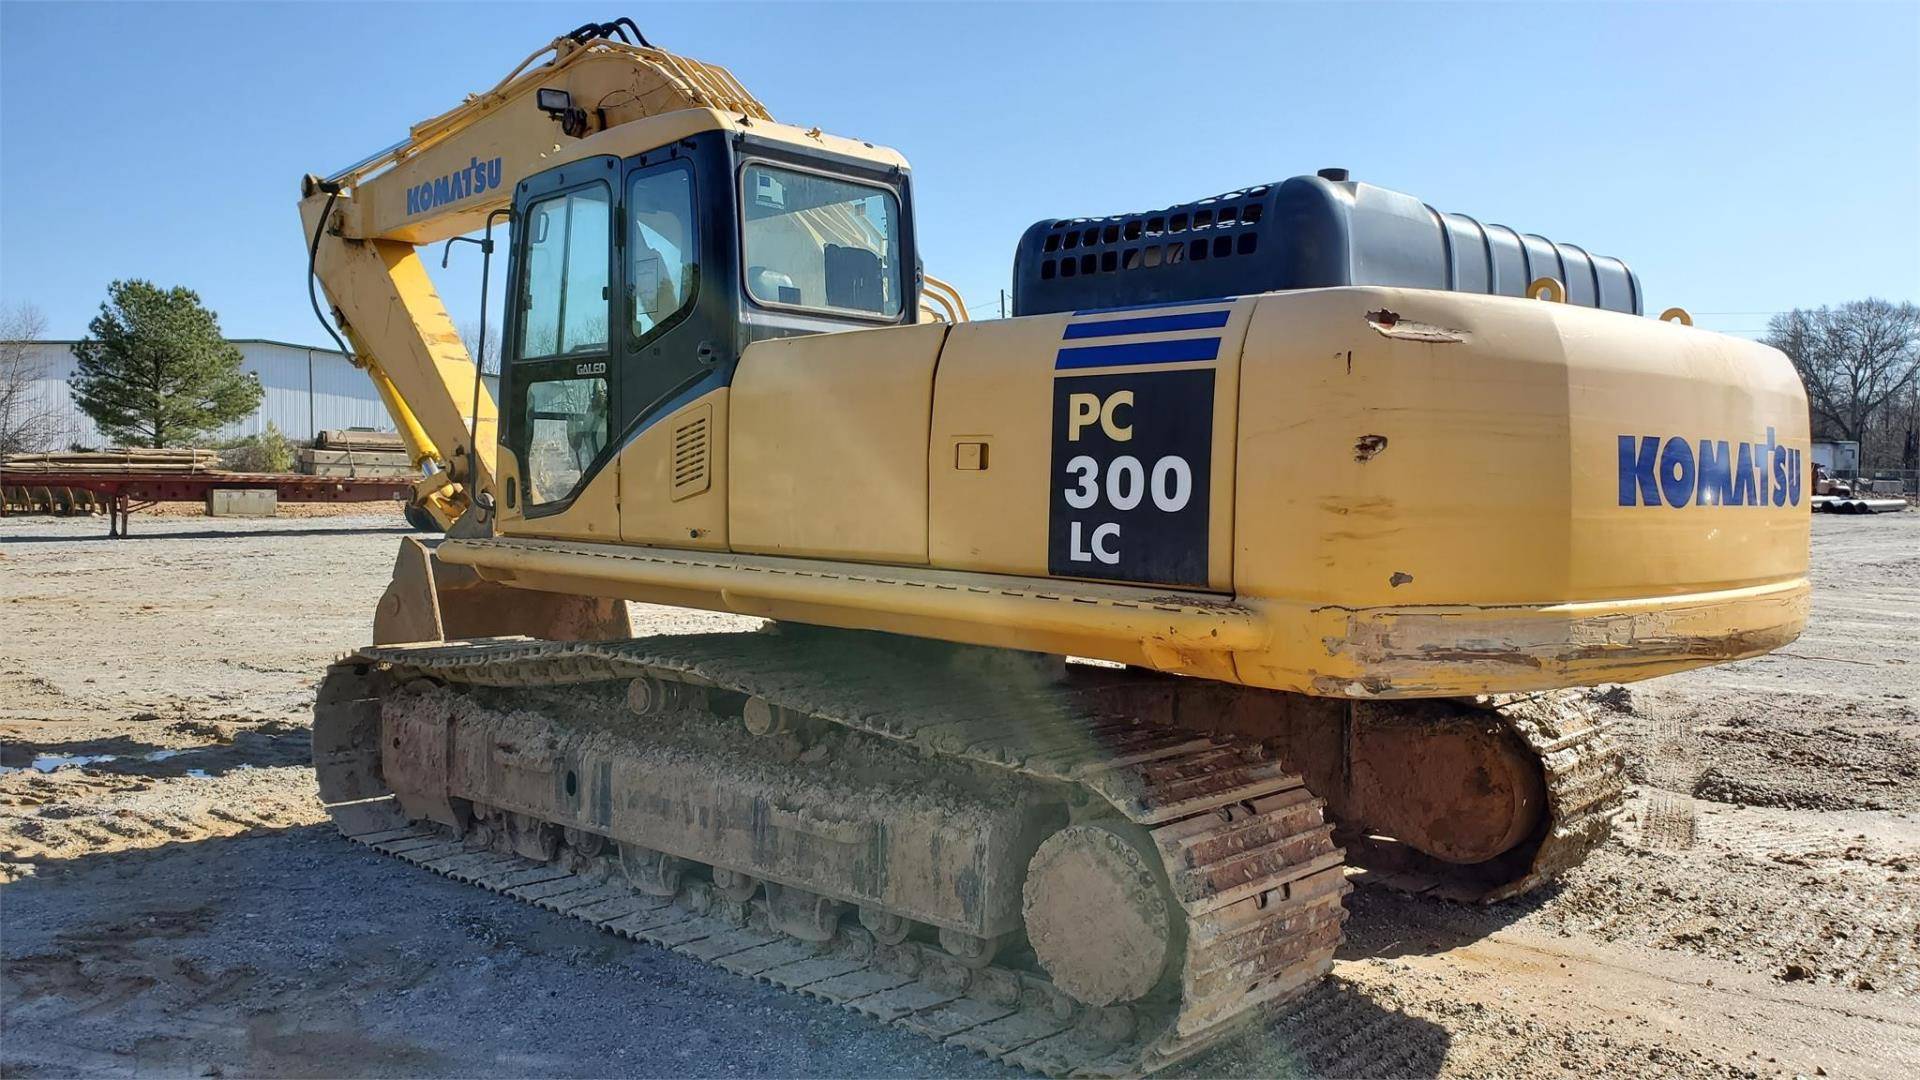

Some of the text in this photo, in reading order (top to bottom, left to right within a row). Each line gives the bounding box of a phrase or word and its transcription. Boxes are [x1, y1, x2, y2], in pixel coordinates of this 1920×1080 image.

[407, 157, 502, 216] KOMATSU
[576, 362, 606, 375] GALEO
[1068, 390, 1134, 442] PC
[1064, 455, 1192, 512] 300
[1618, 426, 1800, 508] KOMATSU
[1070, 521, 1120, 564] LC
